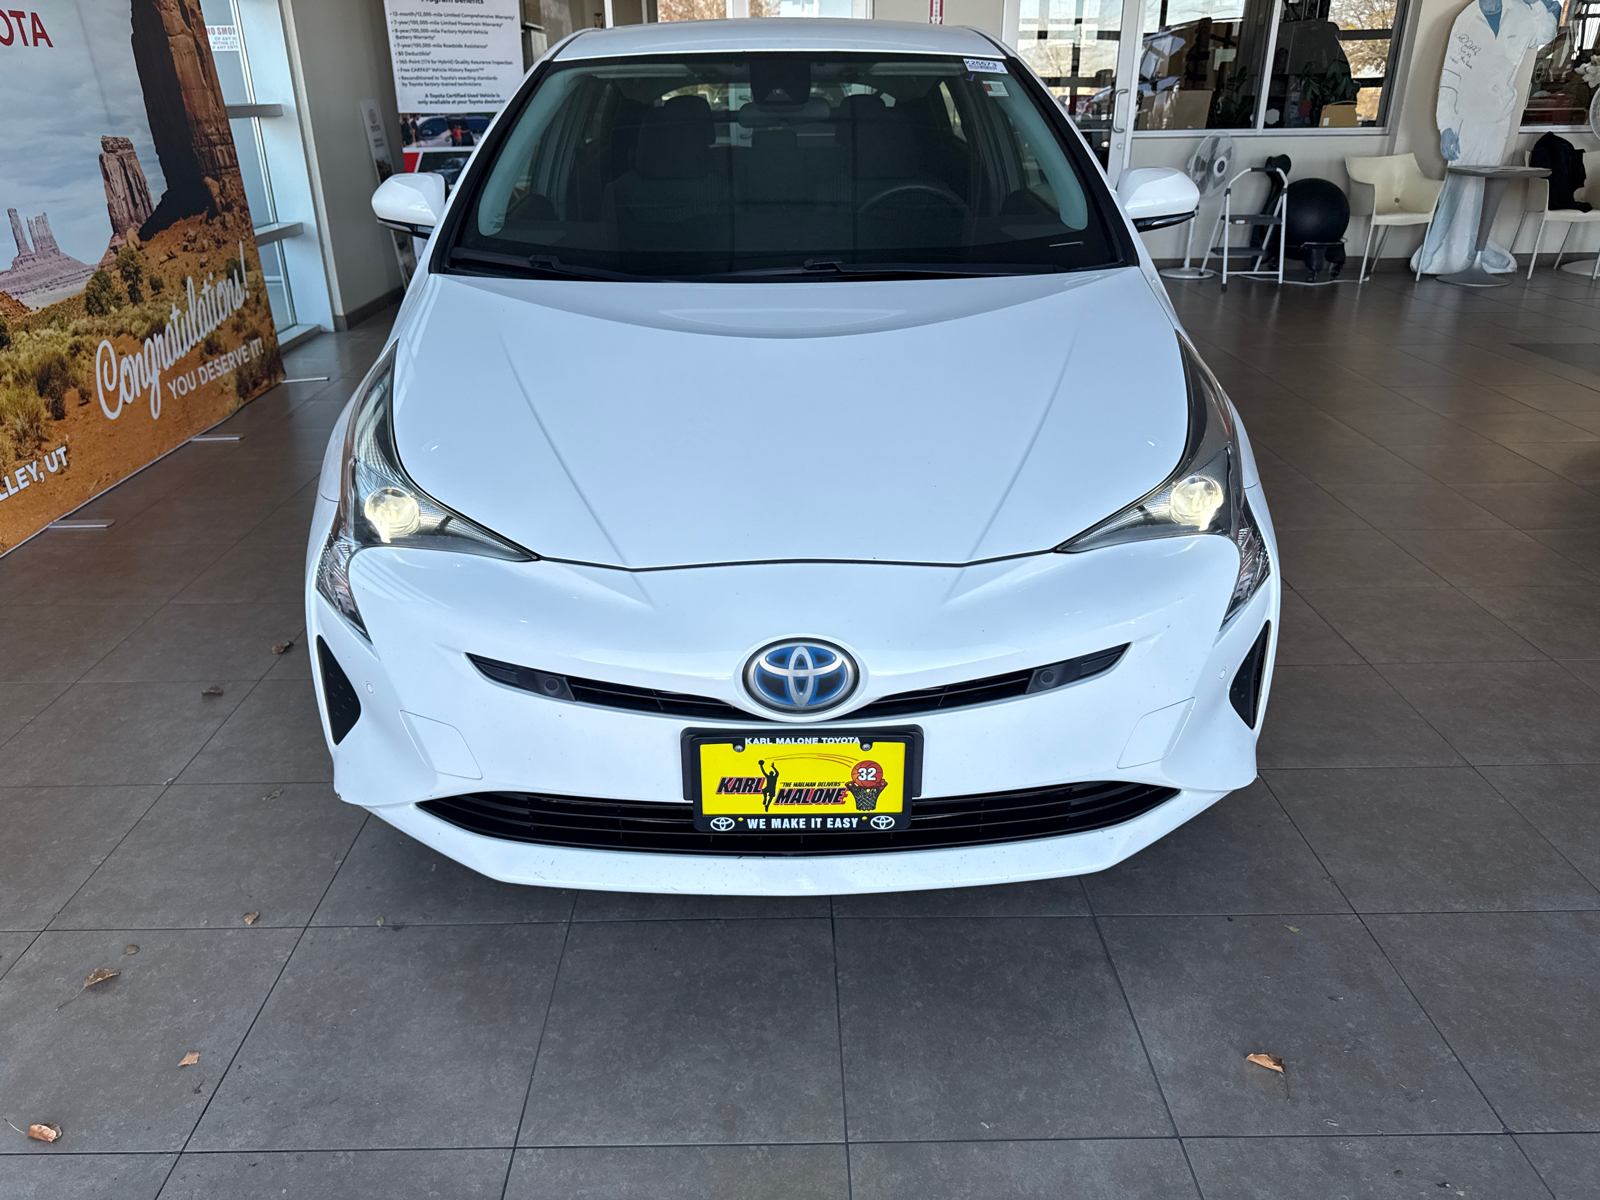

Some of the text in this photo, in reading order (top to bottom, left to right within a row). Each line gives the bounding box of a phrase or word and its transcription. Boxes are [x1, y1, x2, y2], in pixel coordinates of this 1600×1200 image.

[96, 241, 250, 420] Congratulations!
[167, 337, 264, 400] YOU DESERVE IT!
[44, 446, 68, 473] UT
[744, 737, 773, 745] KARL
[776, 737, 818, 745] MALONE
[858, 768, 877, 781] 32
[716, 777, 766, 794] KARL
[774, 787, 848, 806] MALONE
[746, 818, 858, 829] WE MAKE IT EASY
